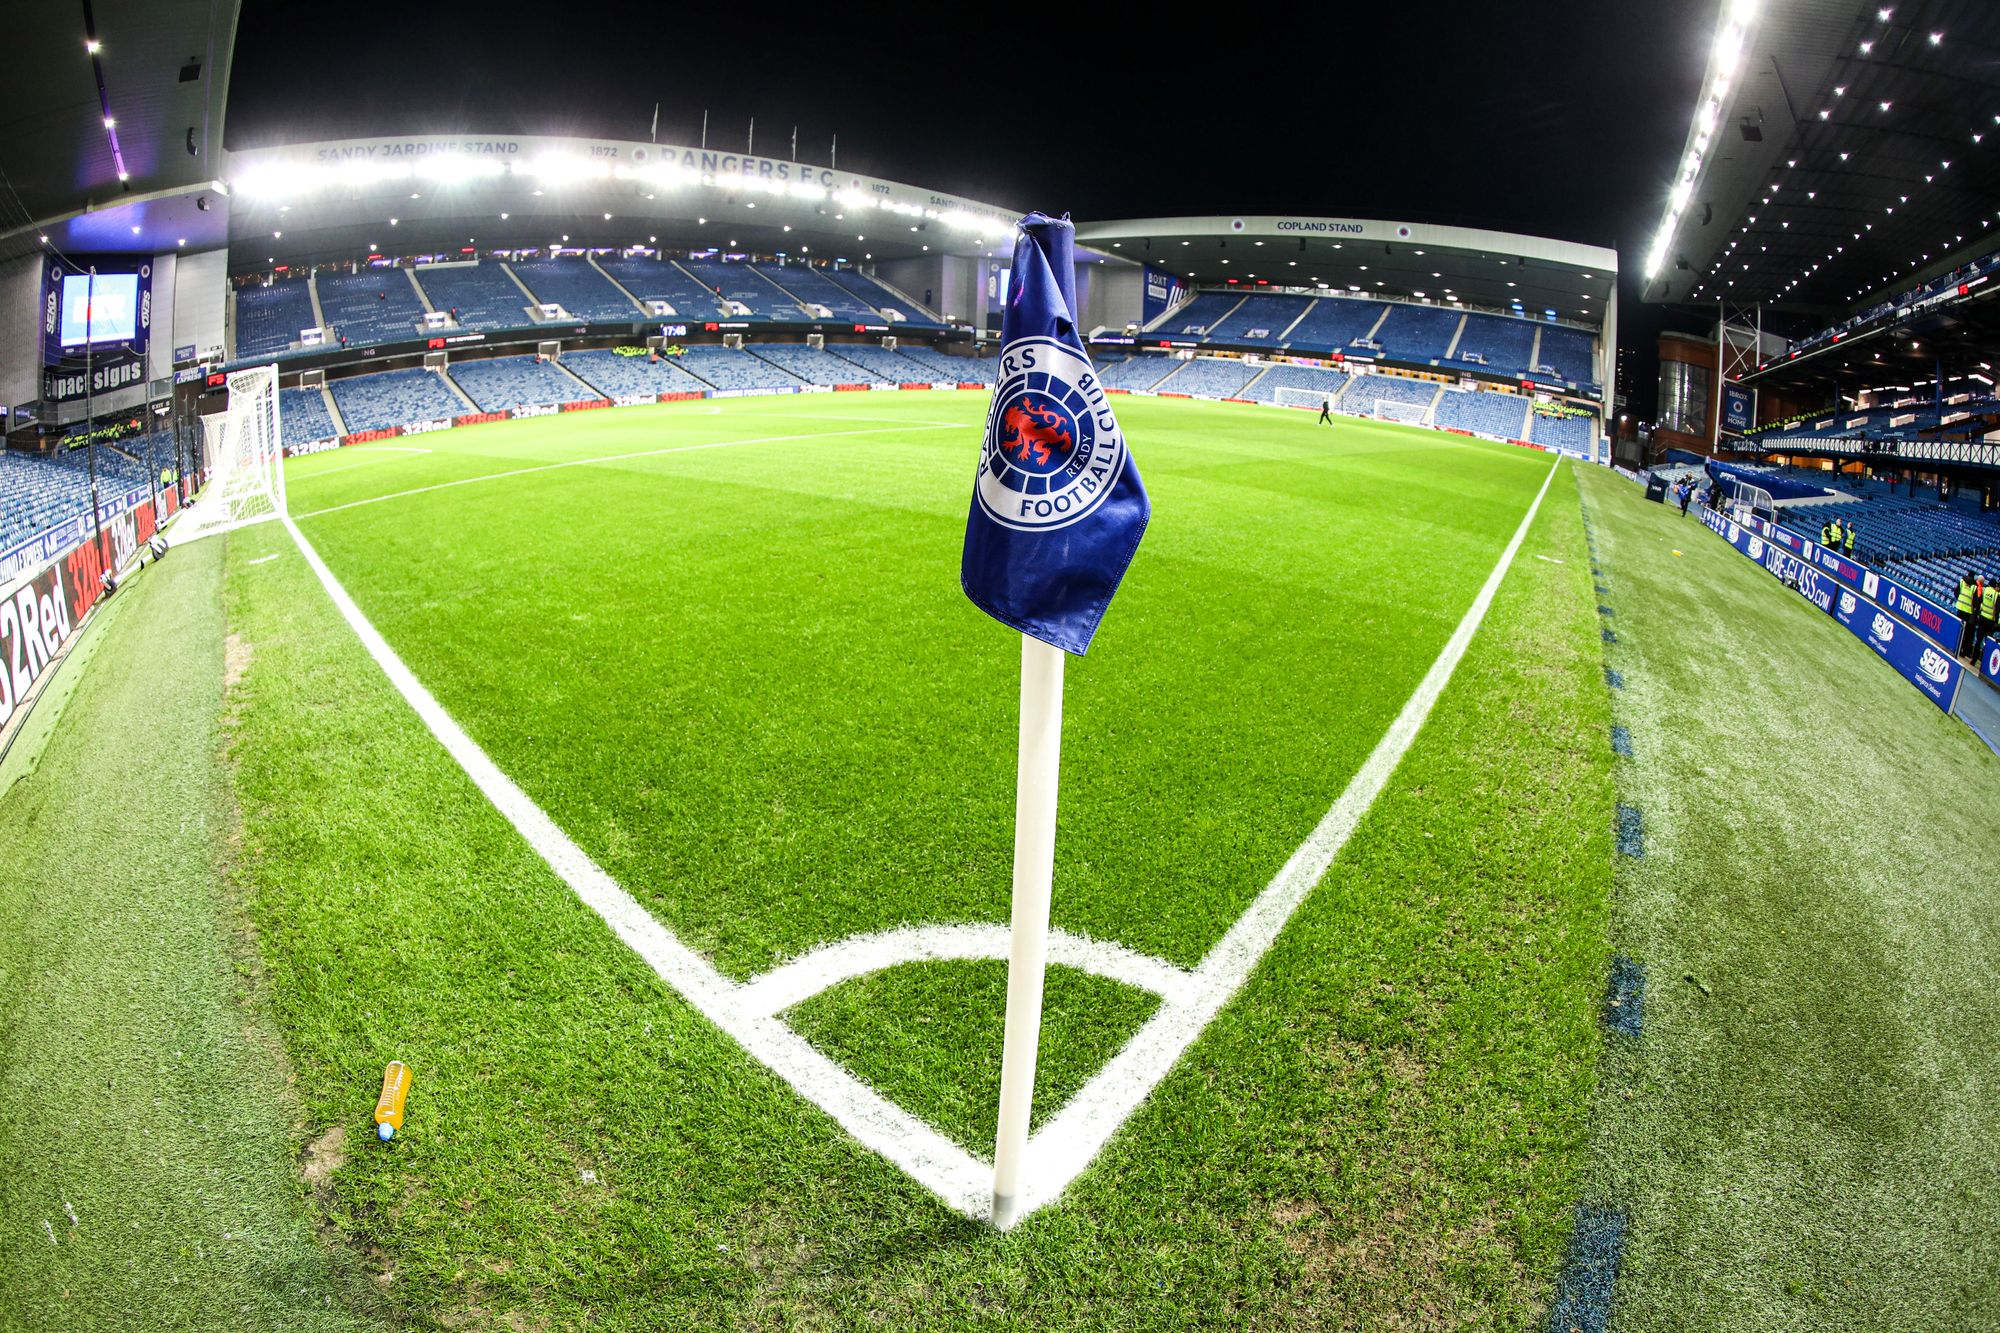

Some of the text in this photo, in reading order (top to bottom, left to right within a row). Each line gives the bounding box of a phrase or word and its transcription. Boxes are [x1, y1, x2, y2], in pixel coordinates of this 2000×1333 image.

[317, 142, 519, 161] SANDY JARDINE STAND
[590, 146, 618, 157] 1872
[659, 148, 790, 180] RANGERS
[871, 184, 891, 194] 1872
[1277, 221, 1364, 234] COPLAND STAND
[1148, 272, 1168, 287] BOXT
[46, 290, 58, 335] SEKO
[140, 289, 151, 330] SEKO
[661, 325, 687, 336] 17:48
[94, 362, 142, 390] signs
[661, 391, 703, 403] 32Red
[711, 386, 794, 398] RANGERS FOOTBALL CLUB
[1729, 390, 1749, 400] IBROX
[564, 399, 609, 413] 32Red
[613, 395, 657, 408] 32Red
[457, 411, 506, 427] 32Red
[511, 404, 559, 419] 32Red
[402, 418, 452, 436] 32Red
[1728, 417, 1746, 427] HOME
[345, 427, 397, 446] 32Red
[1020, 437, 1117, 518] FOOTBALL
[1078, 373, 1115, 433] CLUB
[288, 437, 340, 458] 32Red
[1066, 434, 1093, 478] READY
[1822, 554, 1840, 572] FOLLOW
[1765, 546, 1831, 611] CUBE-GLASS.COM
[1900, 595, 1943, 634] THIS IS IBROX
[1872, 613, 1895, 641] SEKO
[1919, 648, 1950, 683] SEKO
